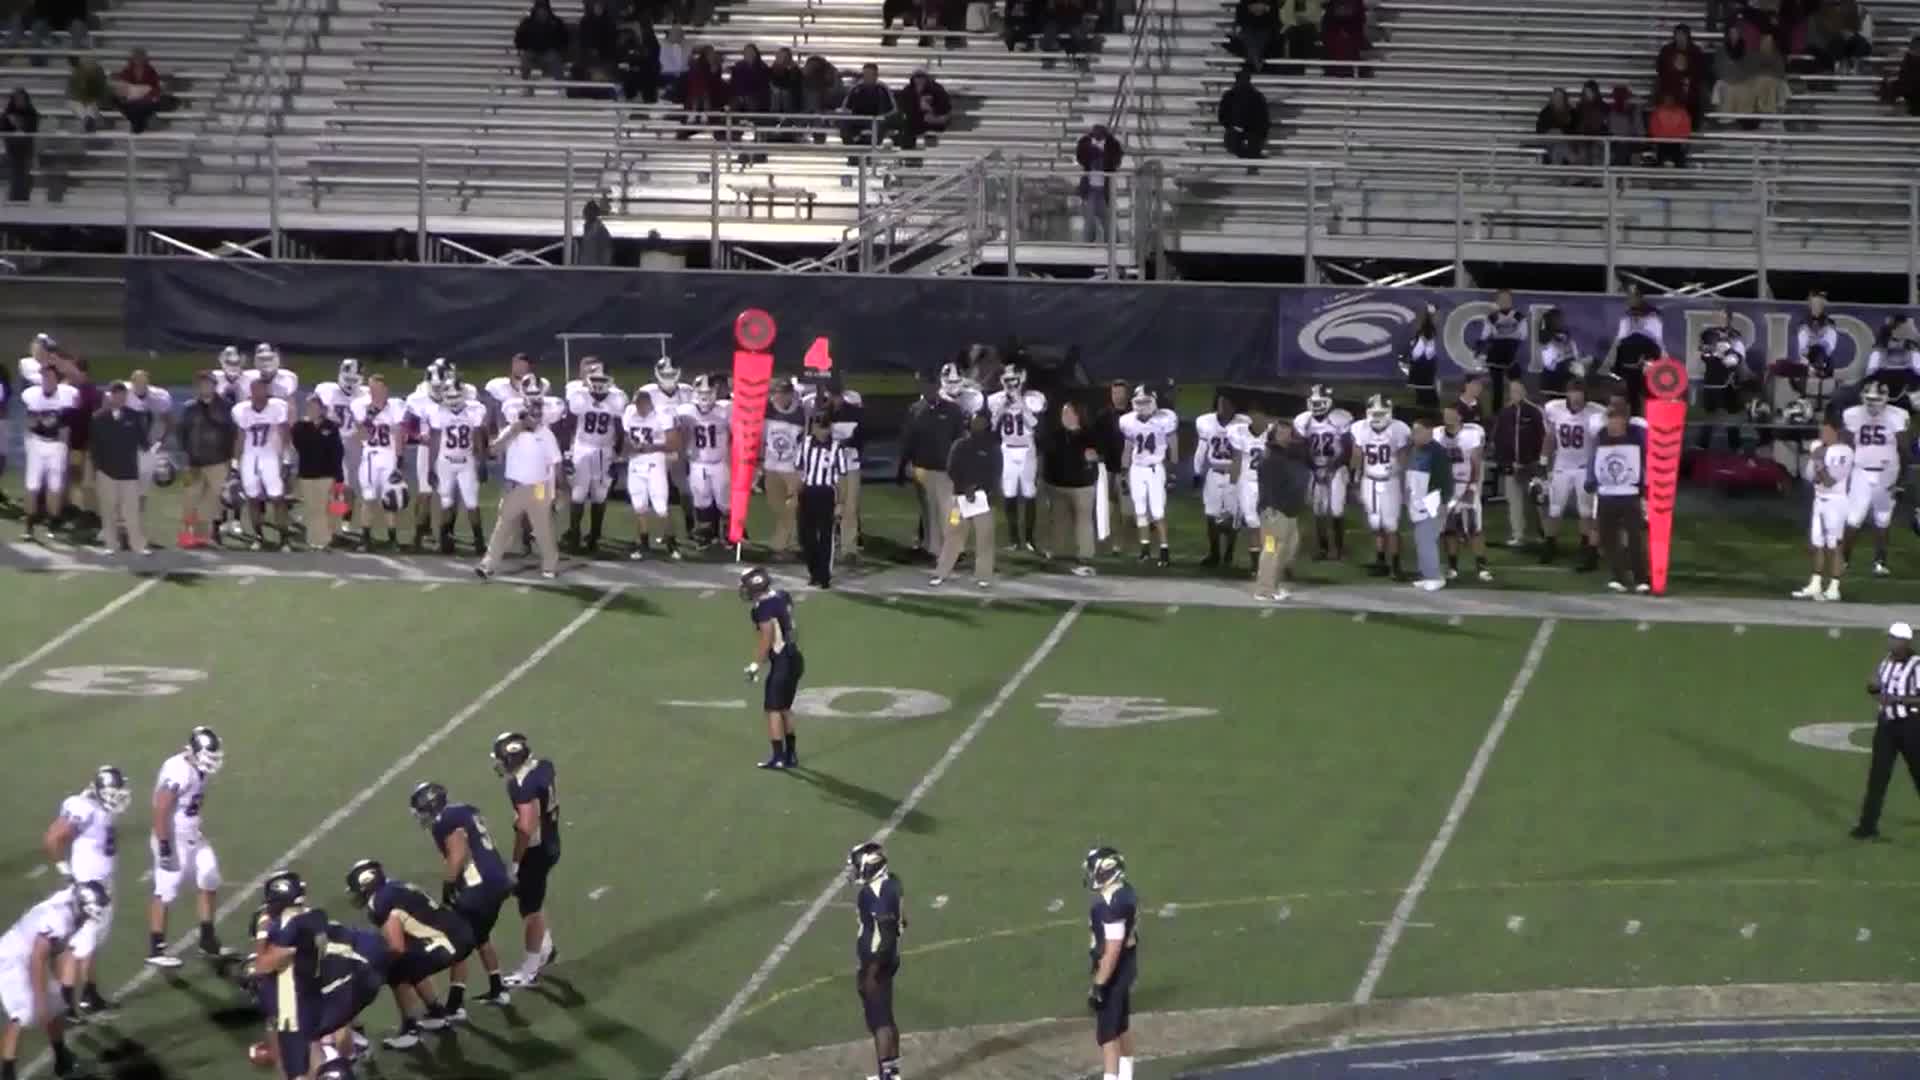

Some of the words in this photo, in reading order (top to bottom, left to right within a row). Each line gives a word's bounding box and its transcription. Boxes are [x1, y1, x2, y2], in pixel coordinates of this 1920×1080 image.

[804, 336, 833, 371] 4
[445, 424, 470, 449] 58
[694, 424, 717, 449] 61
[1860, 424, 1886, 446] 65
[1365, 443, 1391, 466] 50
